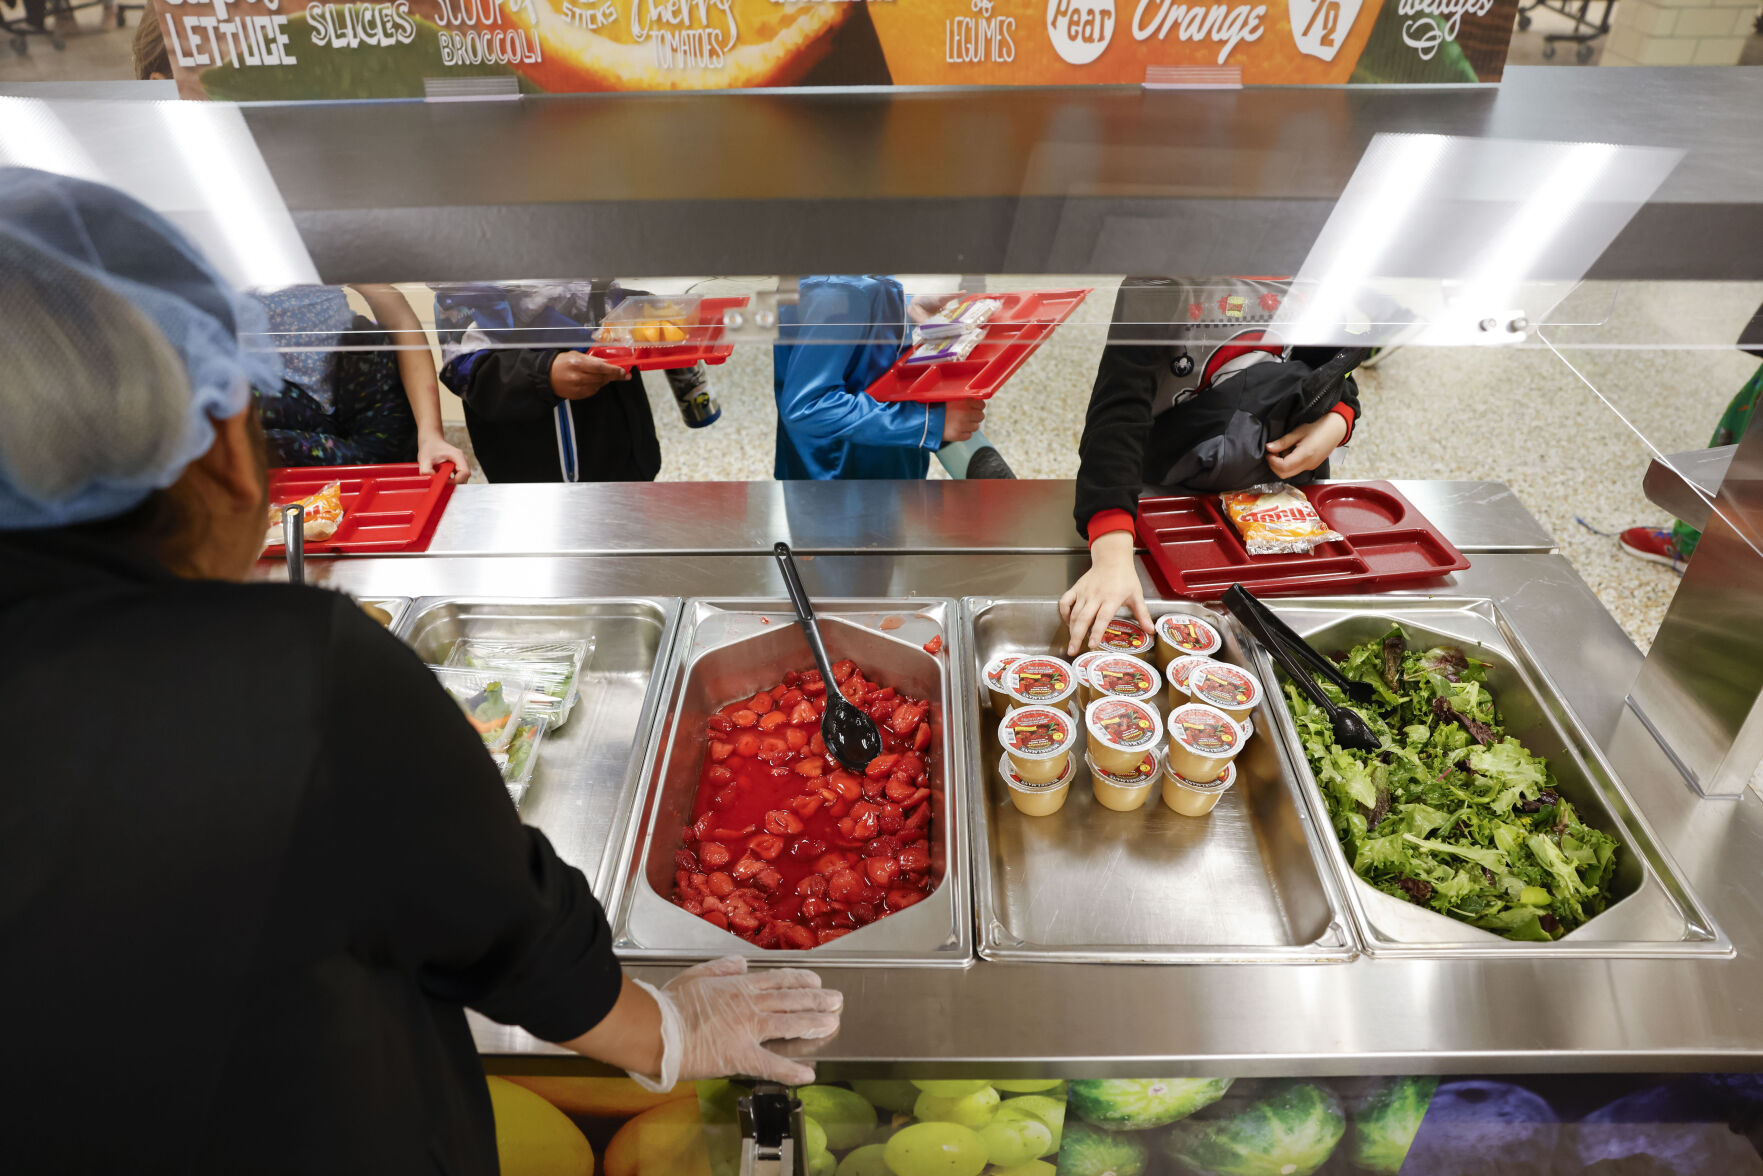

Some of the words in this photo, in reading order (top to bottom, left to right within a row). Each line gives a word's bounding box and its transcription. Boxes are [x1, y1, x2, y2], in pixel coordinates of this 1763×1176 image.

[306, 2, 416, 48] SLICES
[561, 1, 617, 29] STICKS
[631, 0, 737, 51] Cherry
[1051, 0, 1112, 43] Pear
[1132, 0, 1267, 64] Orange
[165, 13, 297, 68] LETTUCE
[438, 29, 542, 65] BROCCOLI
[648, 28, 724, 70] TOMATOES
[946, 16, 1016, 63] LEGUMES
